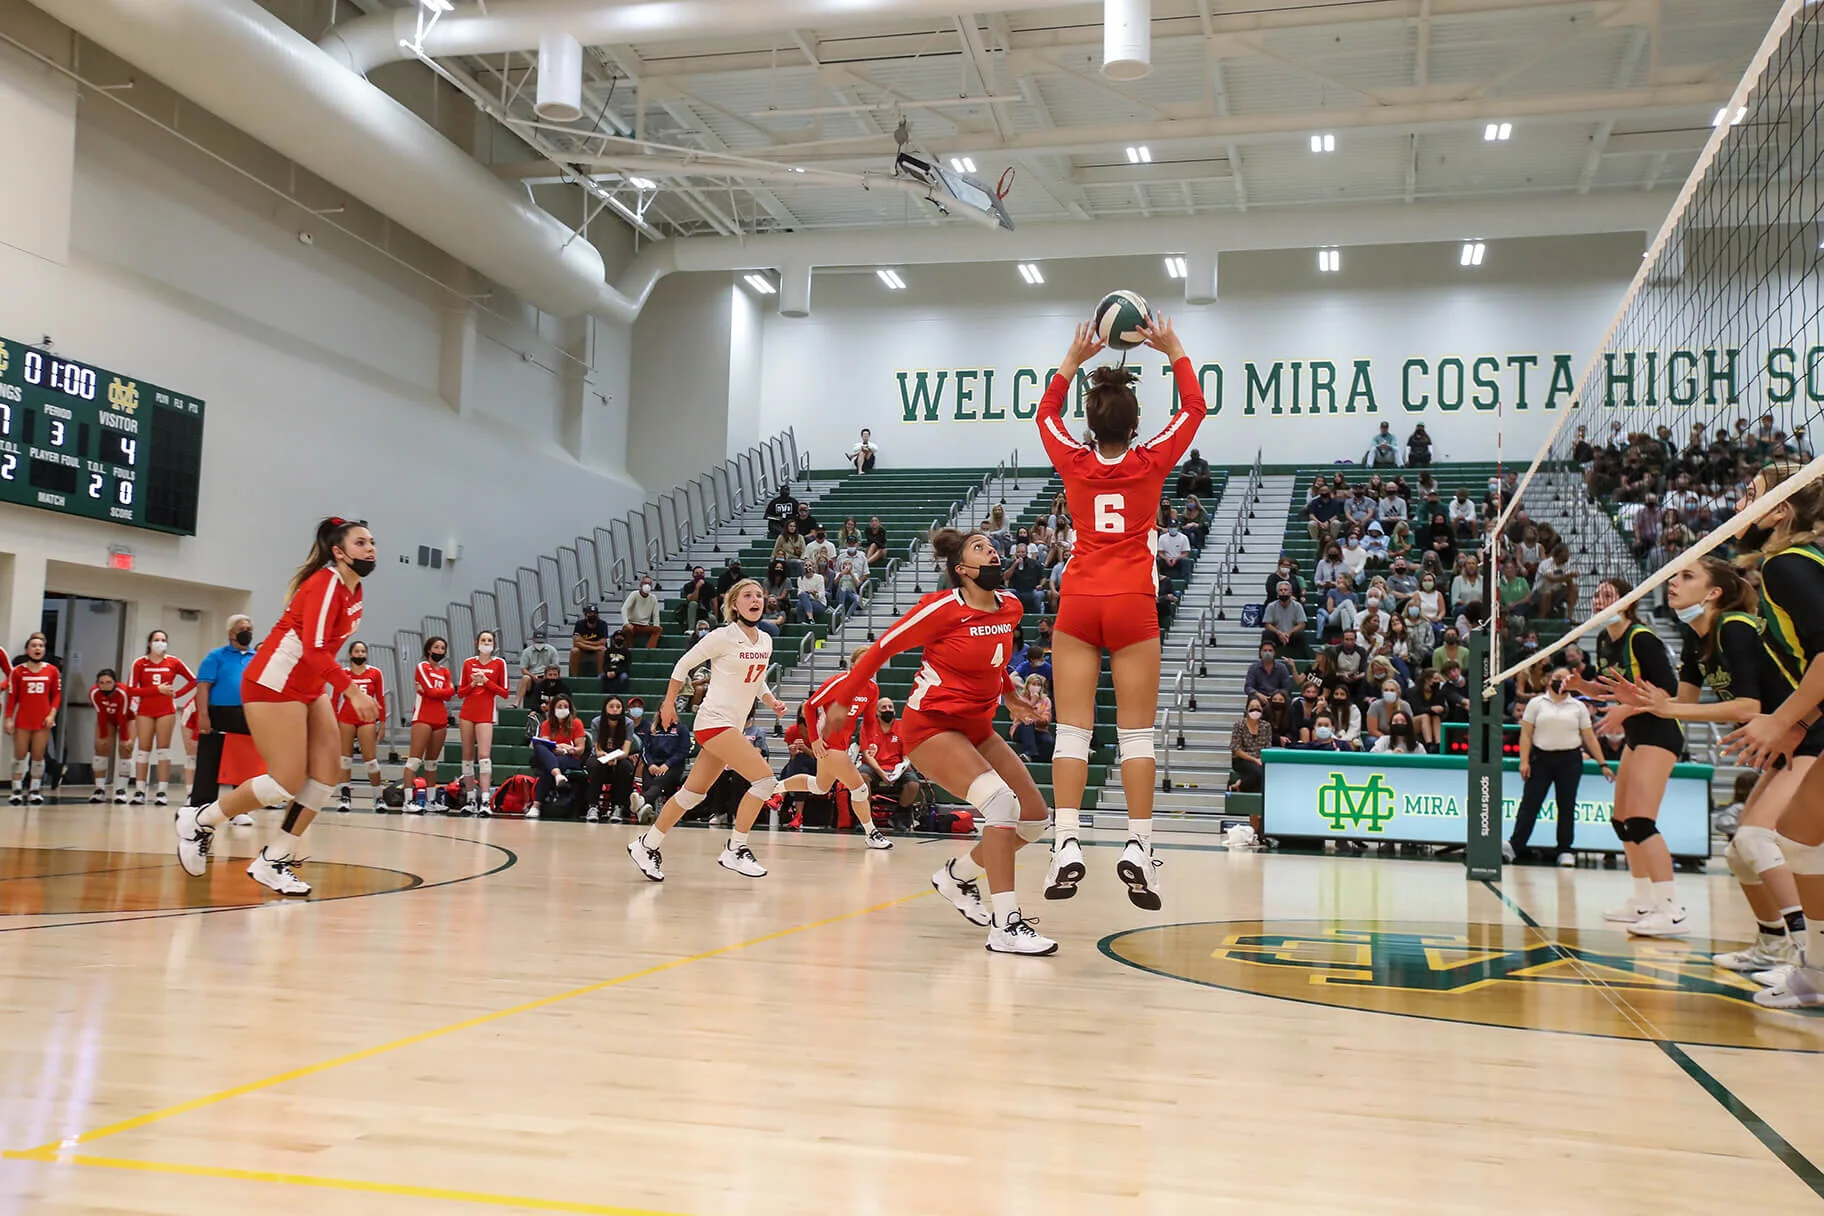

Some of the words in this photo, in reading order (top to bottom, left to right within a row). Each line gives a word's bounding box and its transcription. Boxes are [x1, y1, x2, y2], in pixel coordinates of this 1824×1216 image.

[1162, 364, 1223, 416] TO
[1244, 360, 1378, 415] MIRA
[1402, 354, 1579, 412] COSTA
[1603, 349, 1740, 407] HIGH
[43, 403, 73, 420] PERIOD
[99, 410, 138, 434] VISITOR
[50, 420, 64, 446] 3
[29, 447, 59, 463] PLAYER
[61, 453, 80, 468] FOUL
[120, 437, 136, 465] 4
[1, 454, 17, 480] 2
[113, 467, 136, 481] FOULS
[88, 474, 103, 498] 2
[119, 481, 133, 505] 0
[37, 492, 65, 506] MATCH
[110, 507, 134, 520] SCORE
[1094, 493, 1125, 533] 6
[969, 623, 1012, 636] REDONDO
[990, 643, 1004, 668] 4
[152, 673, 161, 685] 9
[744, 664, 766, 683] 17
[847, 704, 859, 716] 5
[1404, 796, 1460, 816] MIRA
